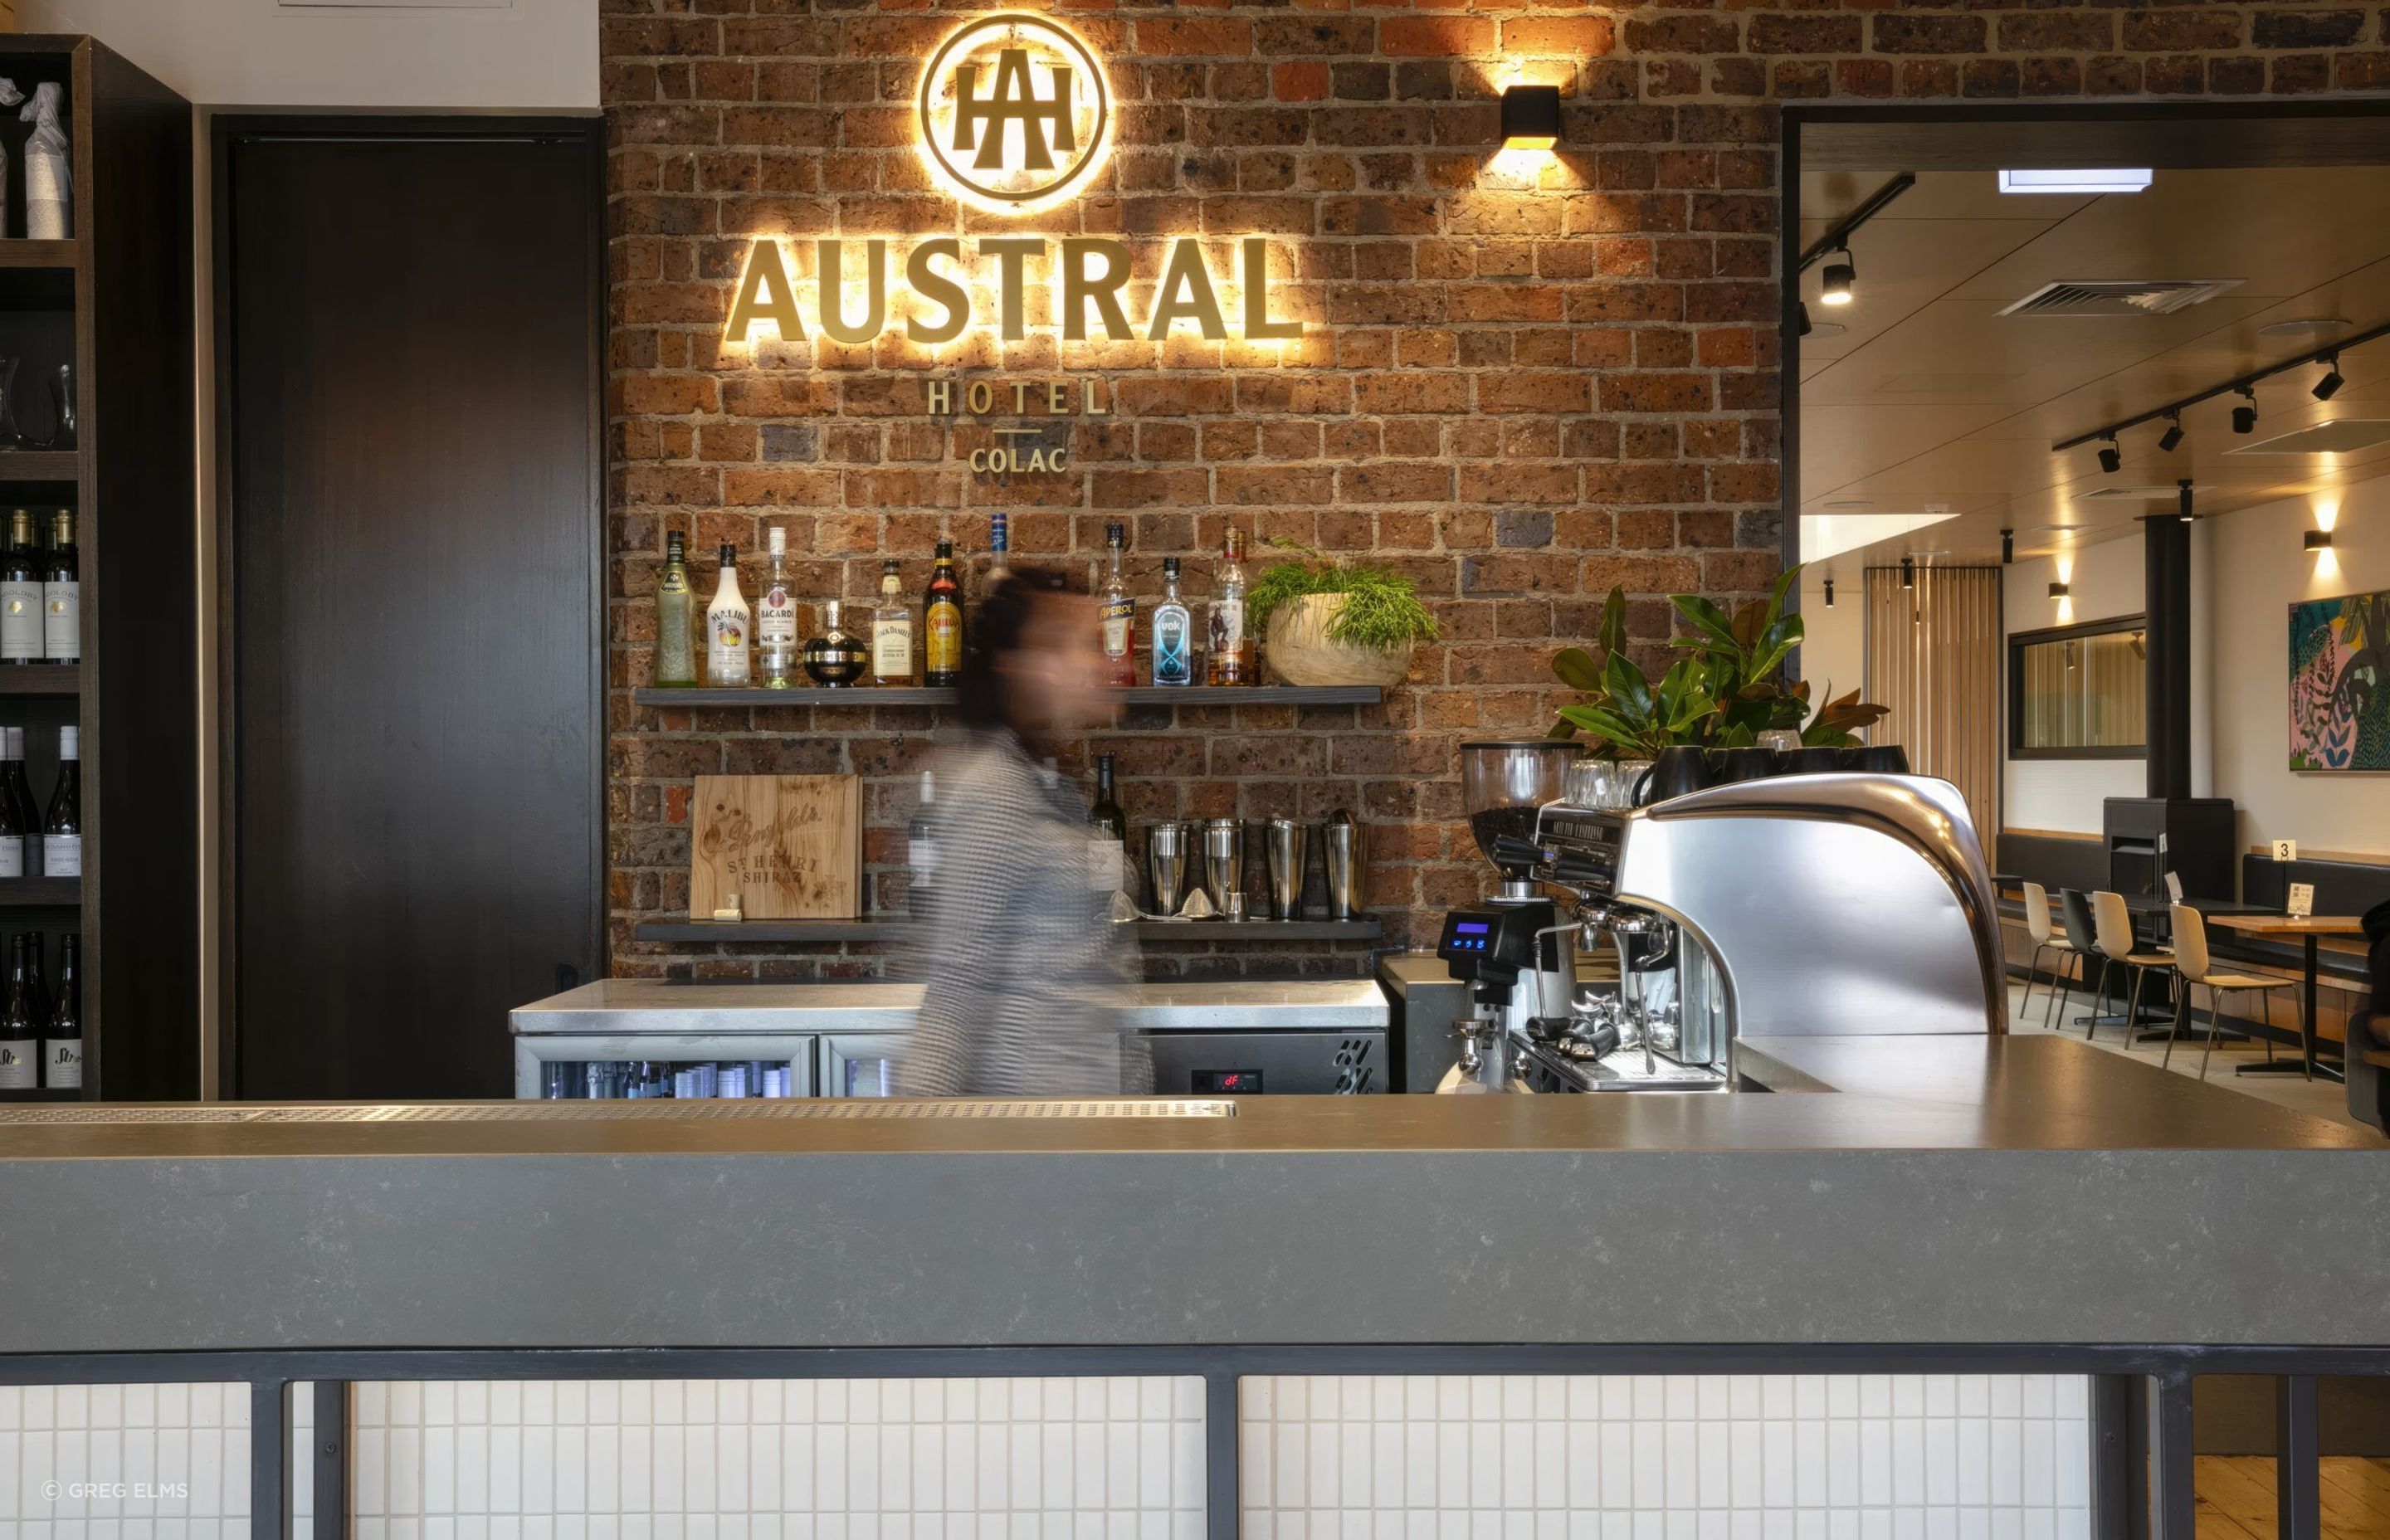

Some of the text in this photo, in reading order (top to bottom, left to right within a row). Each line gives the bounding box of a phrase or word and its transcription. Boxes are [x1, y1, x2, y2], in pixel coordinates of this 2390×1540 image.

[725, 238, 1303, 344] AUSTRAL
[929, 381, 1106, 415] HOTEL
[969, 448, 1066, 473] COLAC
[711, 609, 747, 624] MALIBU
[1100, 604, 1132, 619] APEROL
[2280, 843, 2289, 857] 3
